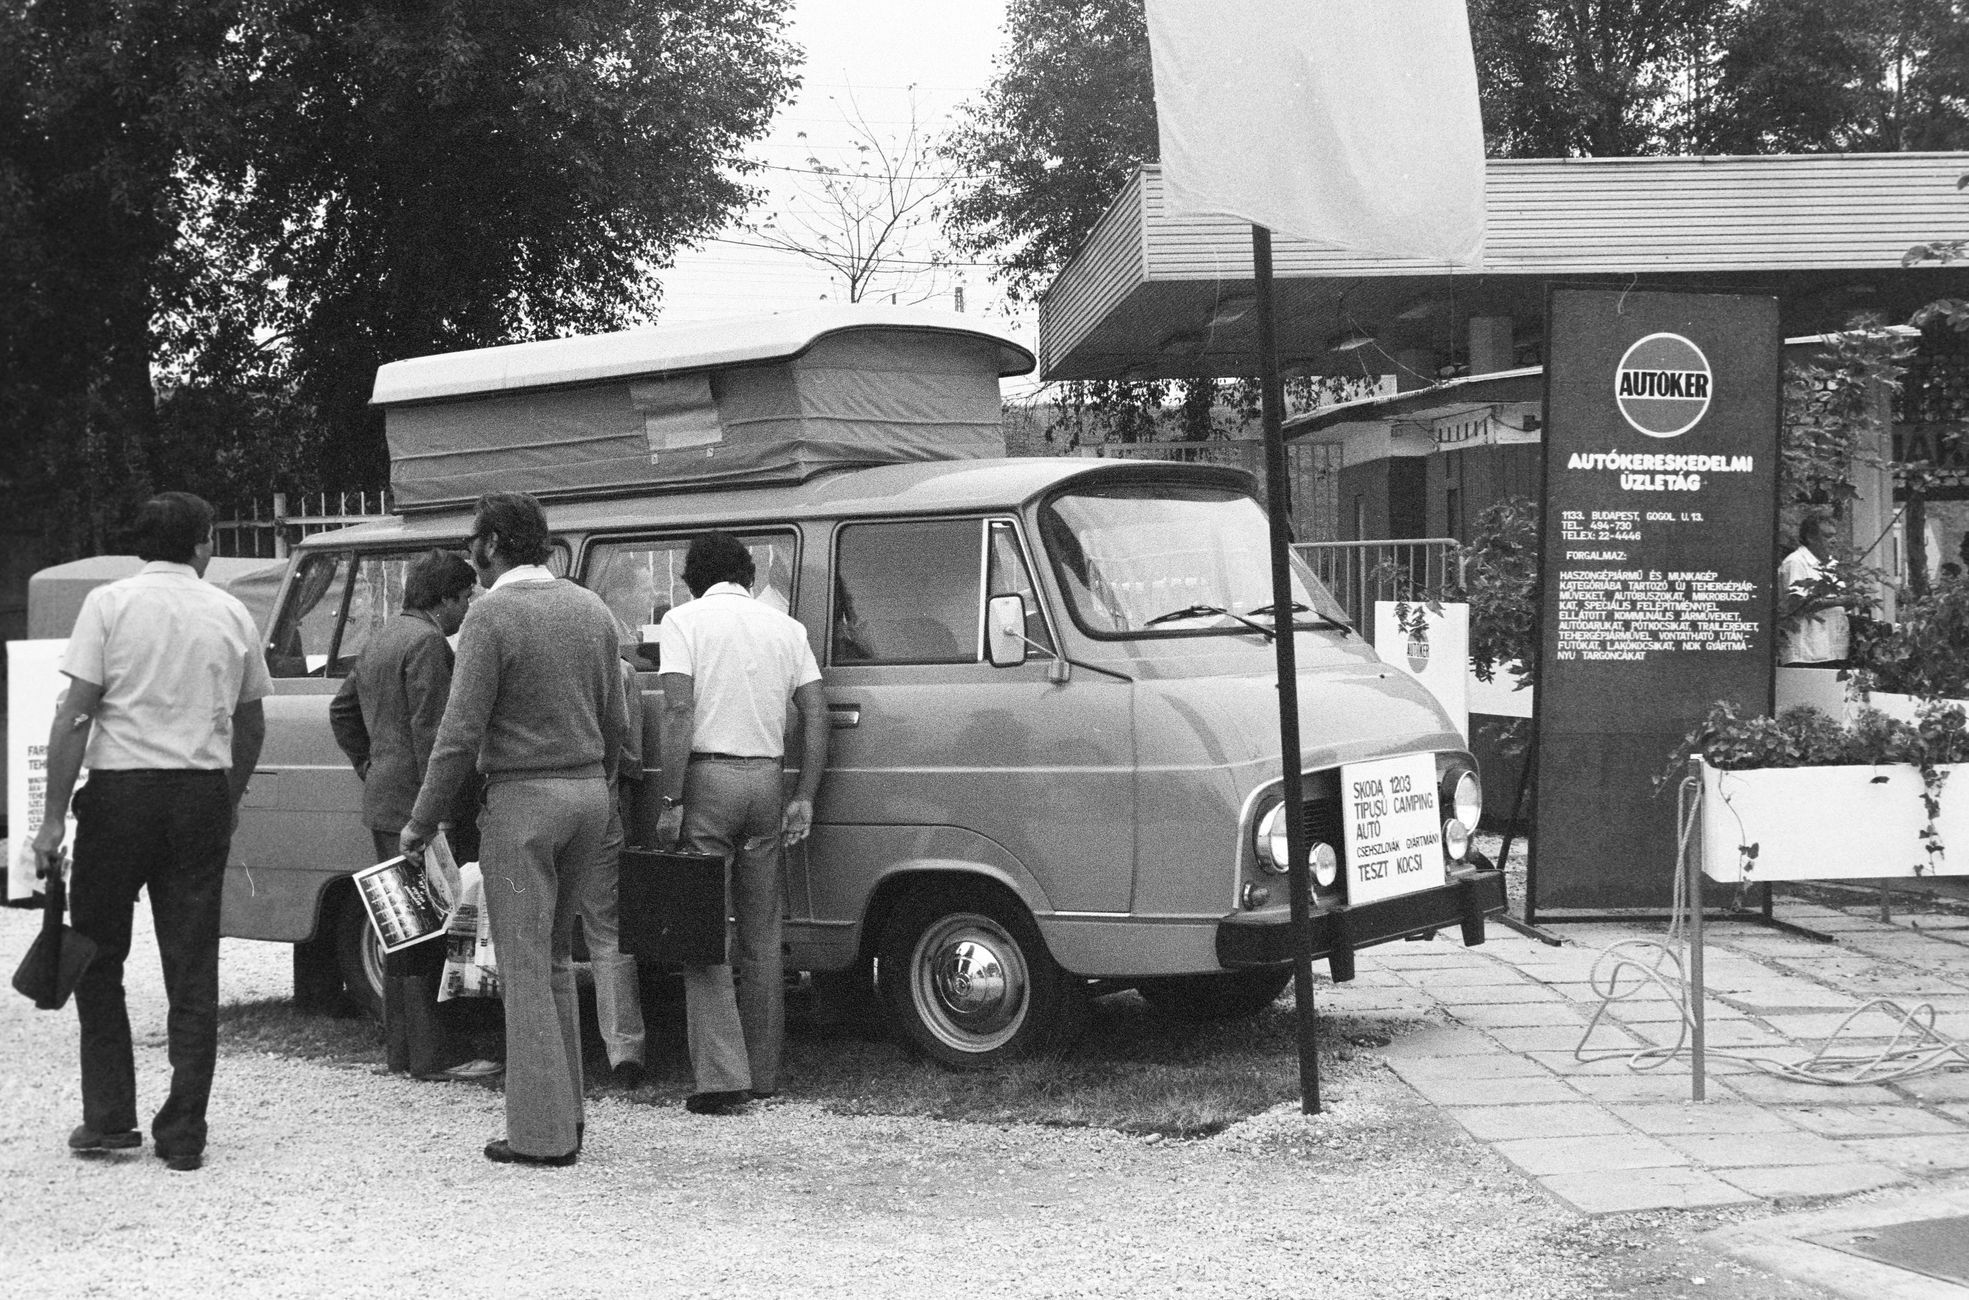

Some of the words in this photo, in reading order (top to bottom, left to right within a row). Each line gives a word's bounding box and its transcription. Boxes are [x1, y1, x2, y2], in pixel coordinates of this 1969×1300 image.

[1567, 449, 1753, 472] AUTÓKERESKEDELMI
[1620, 471, 1700, 491] ÜZLETÁG
[1562, 511, 1585, 520] 1133.
[1592, 511, 1640, 521] BUDAPEST,
[1646, 512, 1676, 521] GOGOL
[1681, 512, 1689, 521] U.
[1691, 513, 1704, 521] 13.
[1561, 521, 1583, 530] TEL.
[1590, 521, 1632, 530] 494-730
[1561, 531, 1596, 540] TELEX:
[1598, 531, 1641, 540] 22-4446
[1566, 551, 1627, 560] FORGALMAZ:
[1649, 569, 1662, 580] ÉS
[1668, 570, 1718, 581] MUNKAGÉP
[1560, 580, 1622, 590] KATEGÓRIÁBA
[1628, 580, 1668, 591] TARTOZÓ
[1614, 590, 1685, 602] AUTÓBUSZOKAT,
[1559, 601, 1579, 611] KAT,
[1584, 600, 1631, 610] SPECIÁLIS
[1559, 609, 1607, 620] ELLÁTOTT
[1614, 610, 1674, 620] KOMMUNÁLIS
[1559, 620, 1625, 632] AUTÓDARUKAT,
[1630, 620, 1692, 632] PÓTKOCSIKAT,
[1697, 622, 1759, 632] TRAILEREKET,
[1659, 630, 1715, 640] VONTATHATÓ
[1558, 640, 1601, 651] FUTÓKAT,
[1606, 640, 1675, 652] LAKÓKOCSIKAT,
[1682, 641, 1701, 651] NDK
[1581, 650, 1646, 661] TARGONCÁKAT
[1353, 779, 1385, 800] SKODA
[1390, 775, 1411, 794] 1203
[1393, 792, 1433, 814] CAMPING
[1358, 860, 1389, 883] TESZT
[1396, 853, 1423, 875] KOCSI
